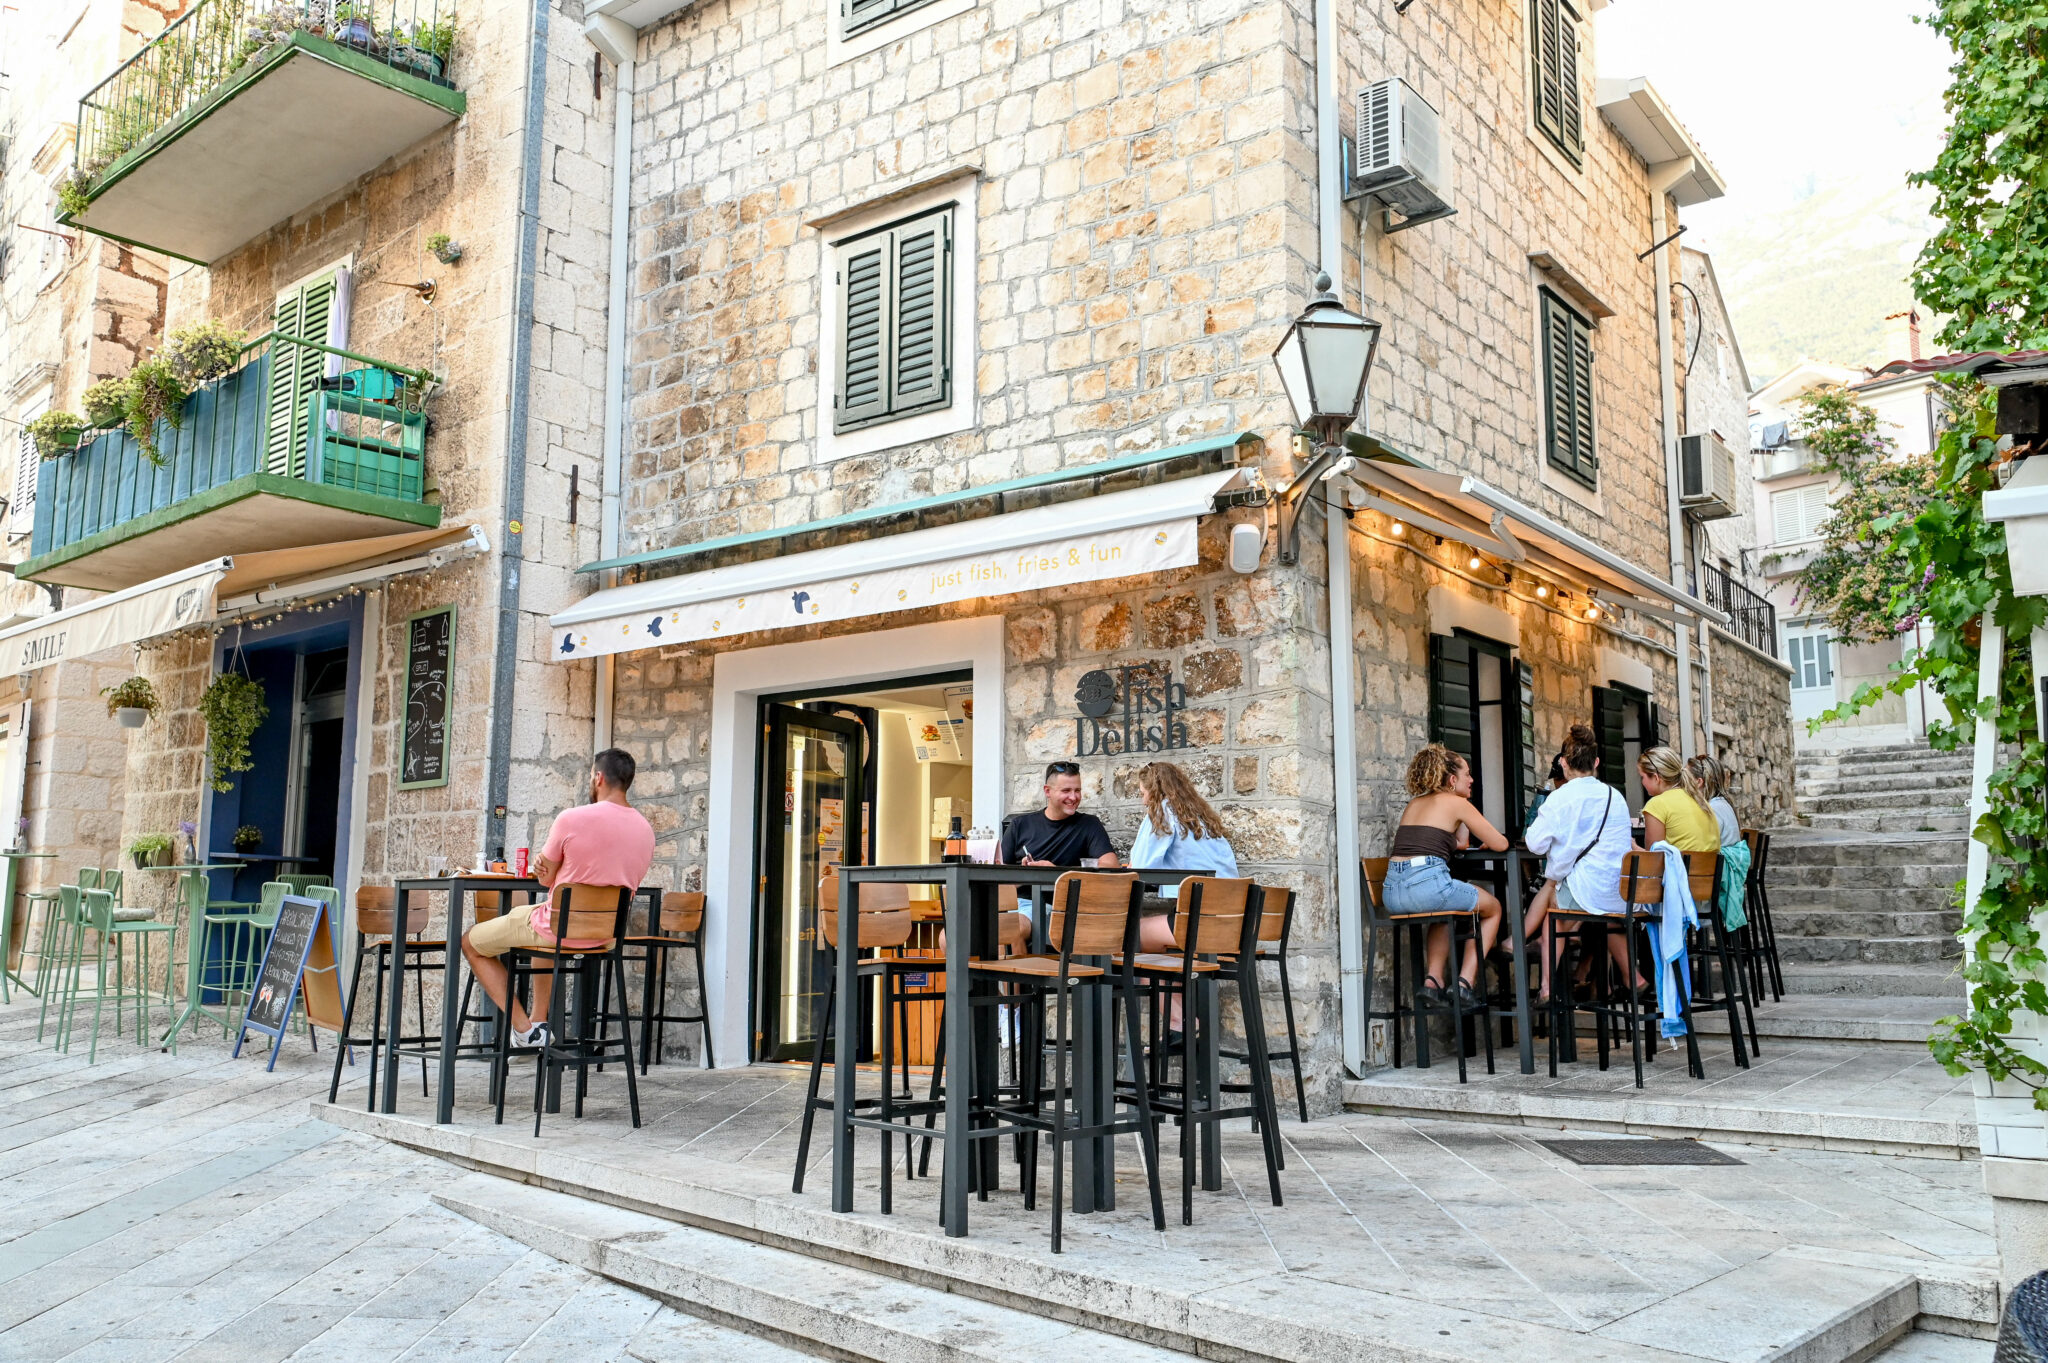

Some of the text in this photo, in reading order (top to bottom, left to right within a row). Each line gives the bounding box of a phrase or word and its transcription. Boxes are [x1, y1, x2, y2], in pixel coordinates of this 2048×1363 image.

[929, 543, 1122, 594] just fish, fries & fun
[21, 631, 67, 666] SMILE
[1074, 714, 1189, 758] Delish
